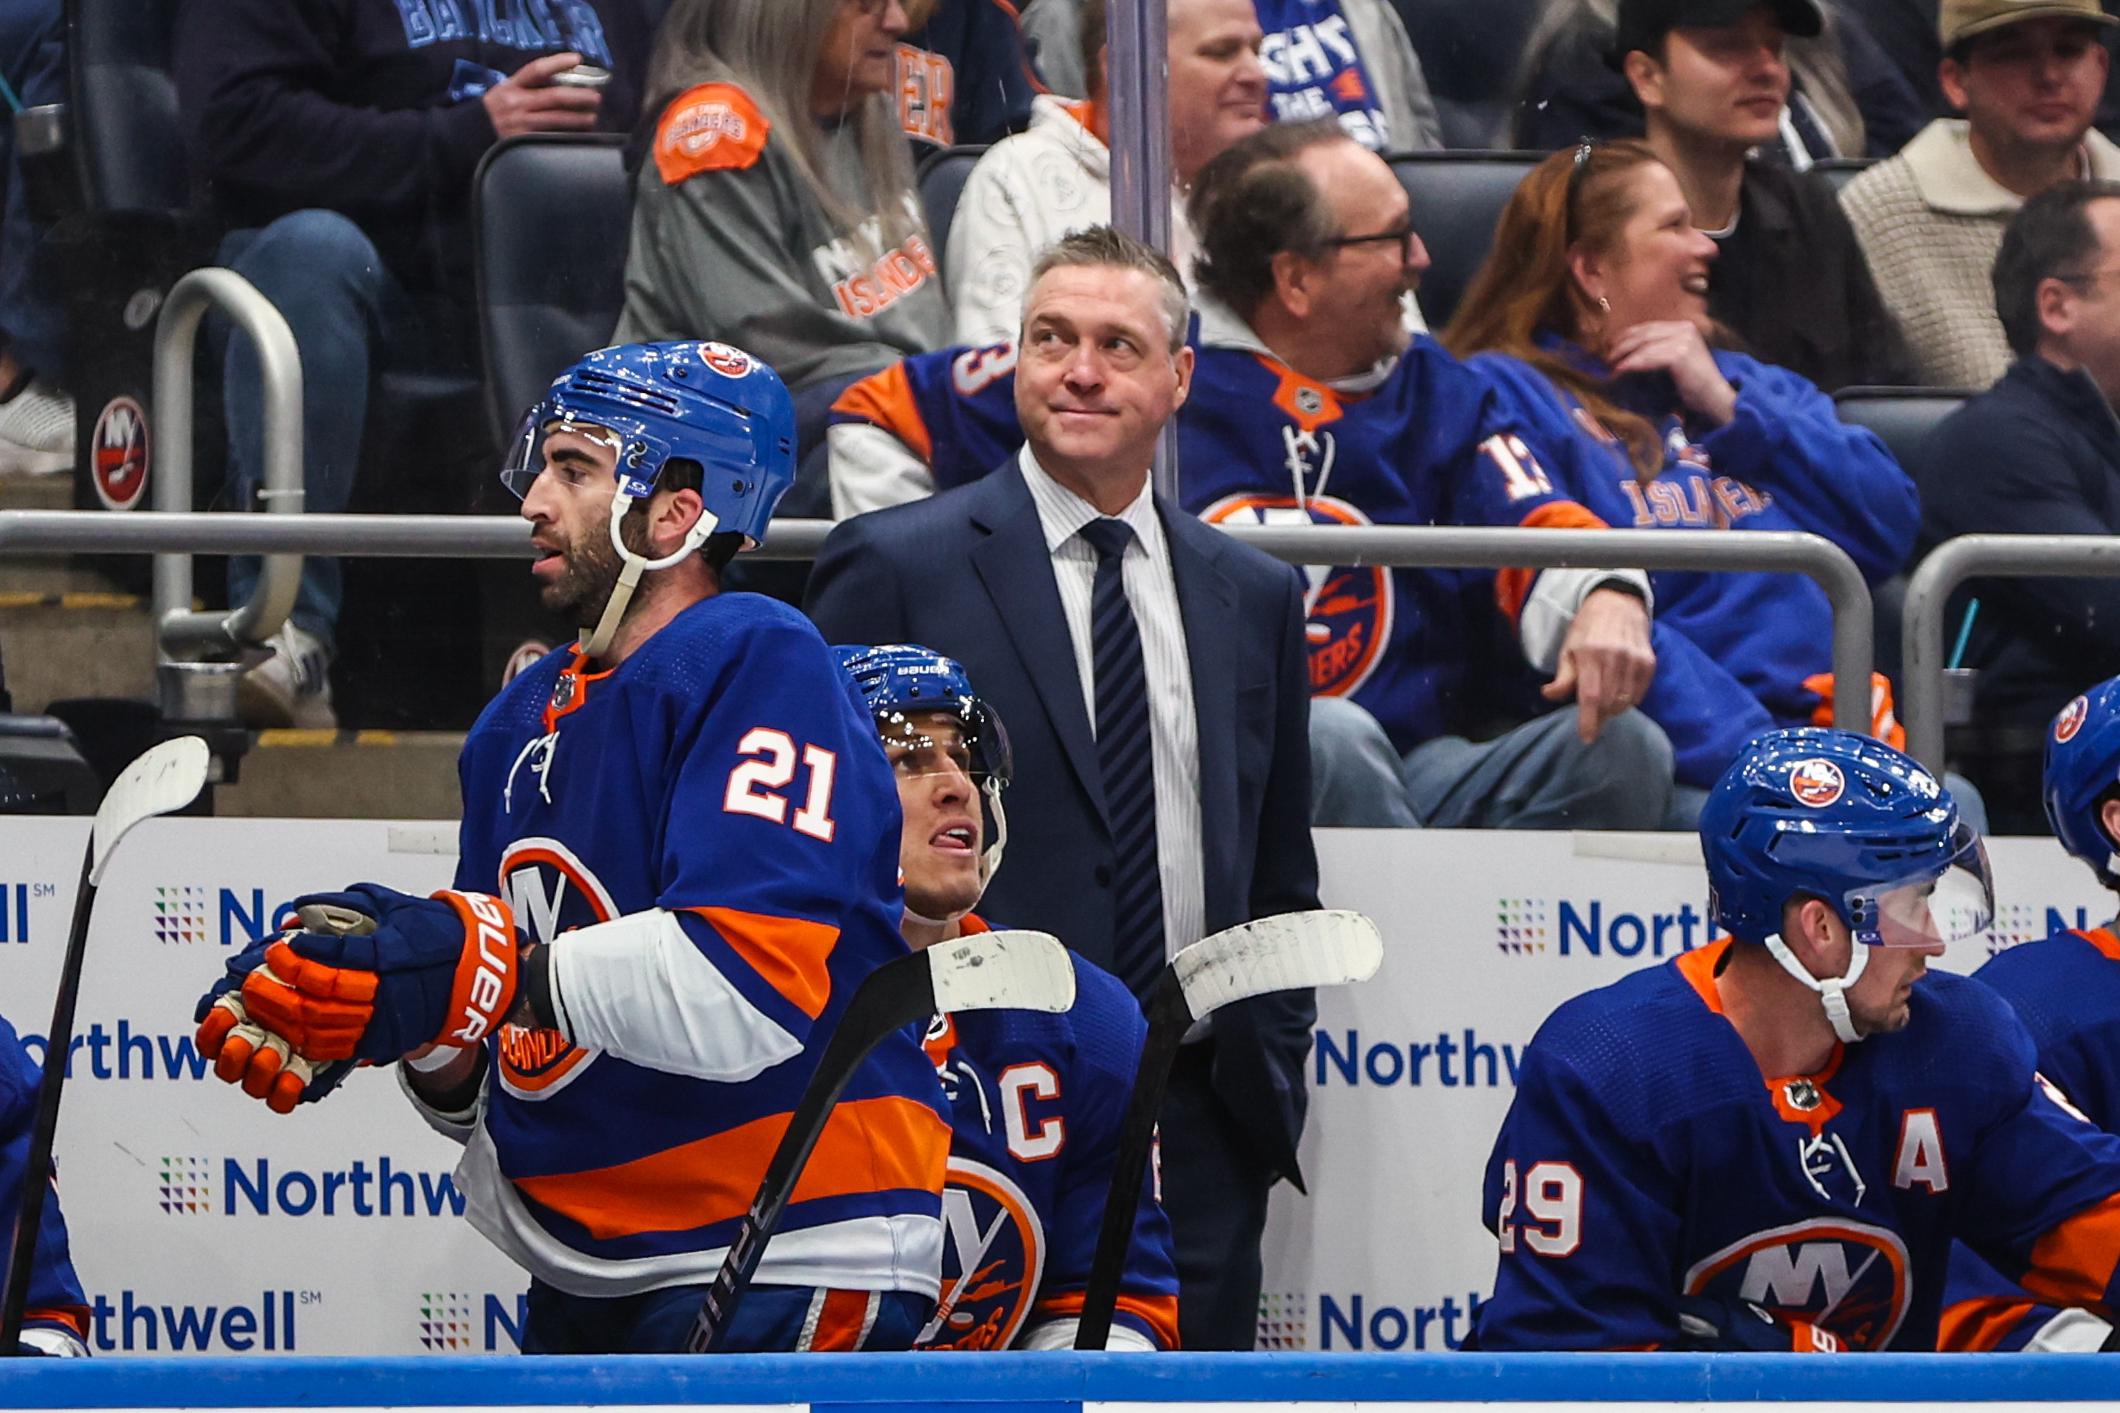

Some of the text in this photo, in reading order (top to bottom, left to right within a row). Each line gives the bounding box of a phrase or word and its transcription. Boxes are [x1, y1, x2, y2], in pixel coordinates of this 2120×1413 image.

[723, 727, 837, 842] 21
[452, 889, 510, 1043] AUER
[998, 1060, 1066, 1164] C
[1889, 1106, 1951, 1197] A
[1498, 1157, 1585, 1259] 29
